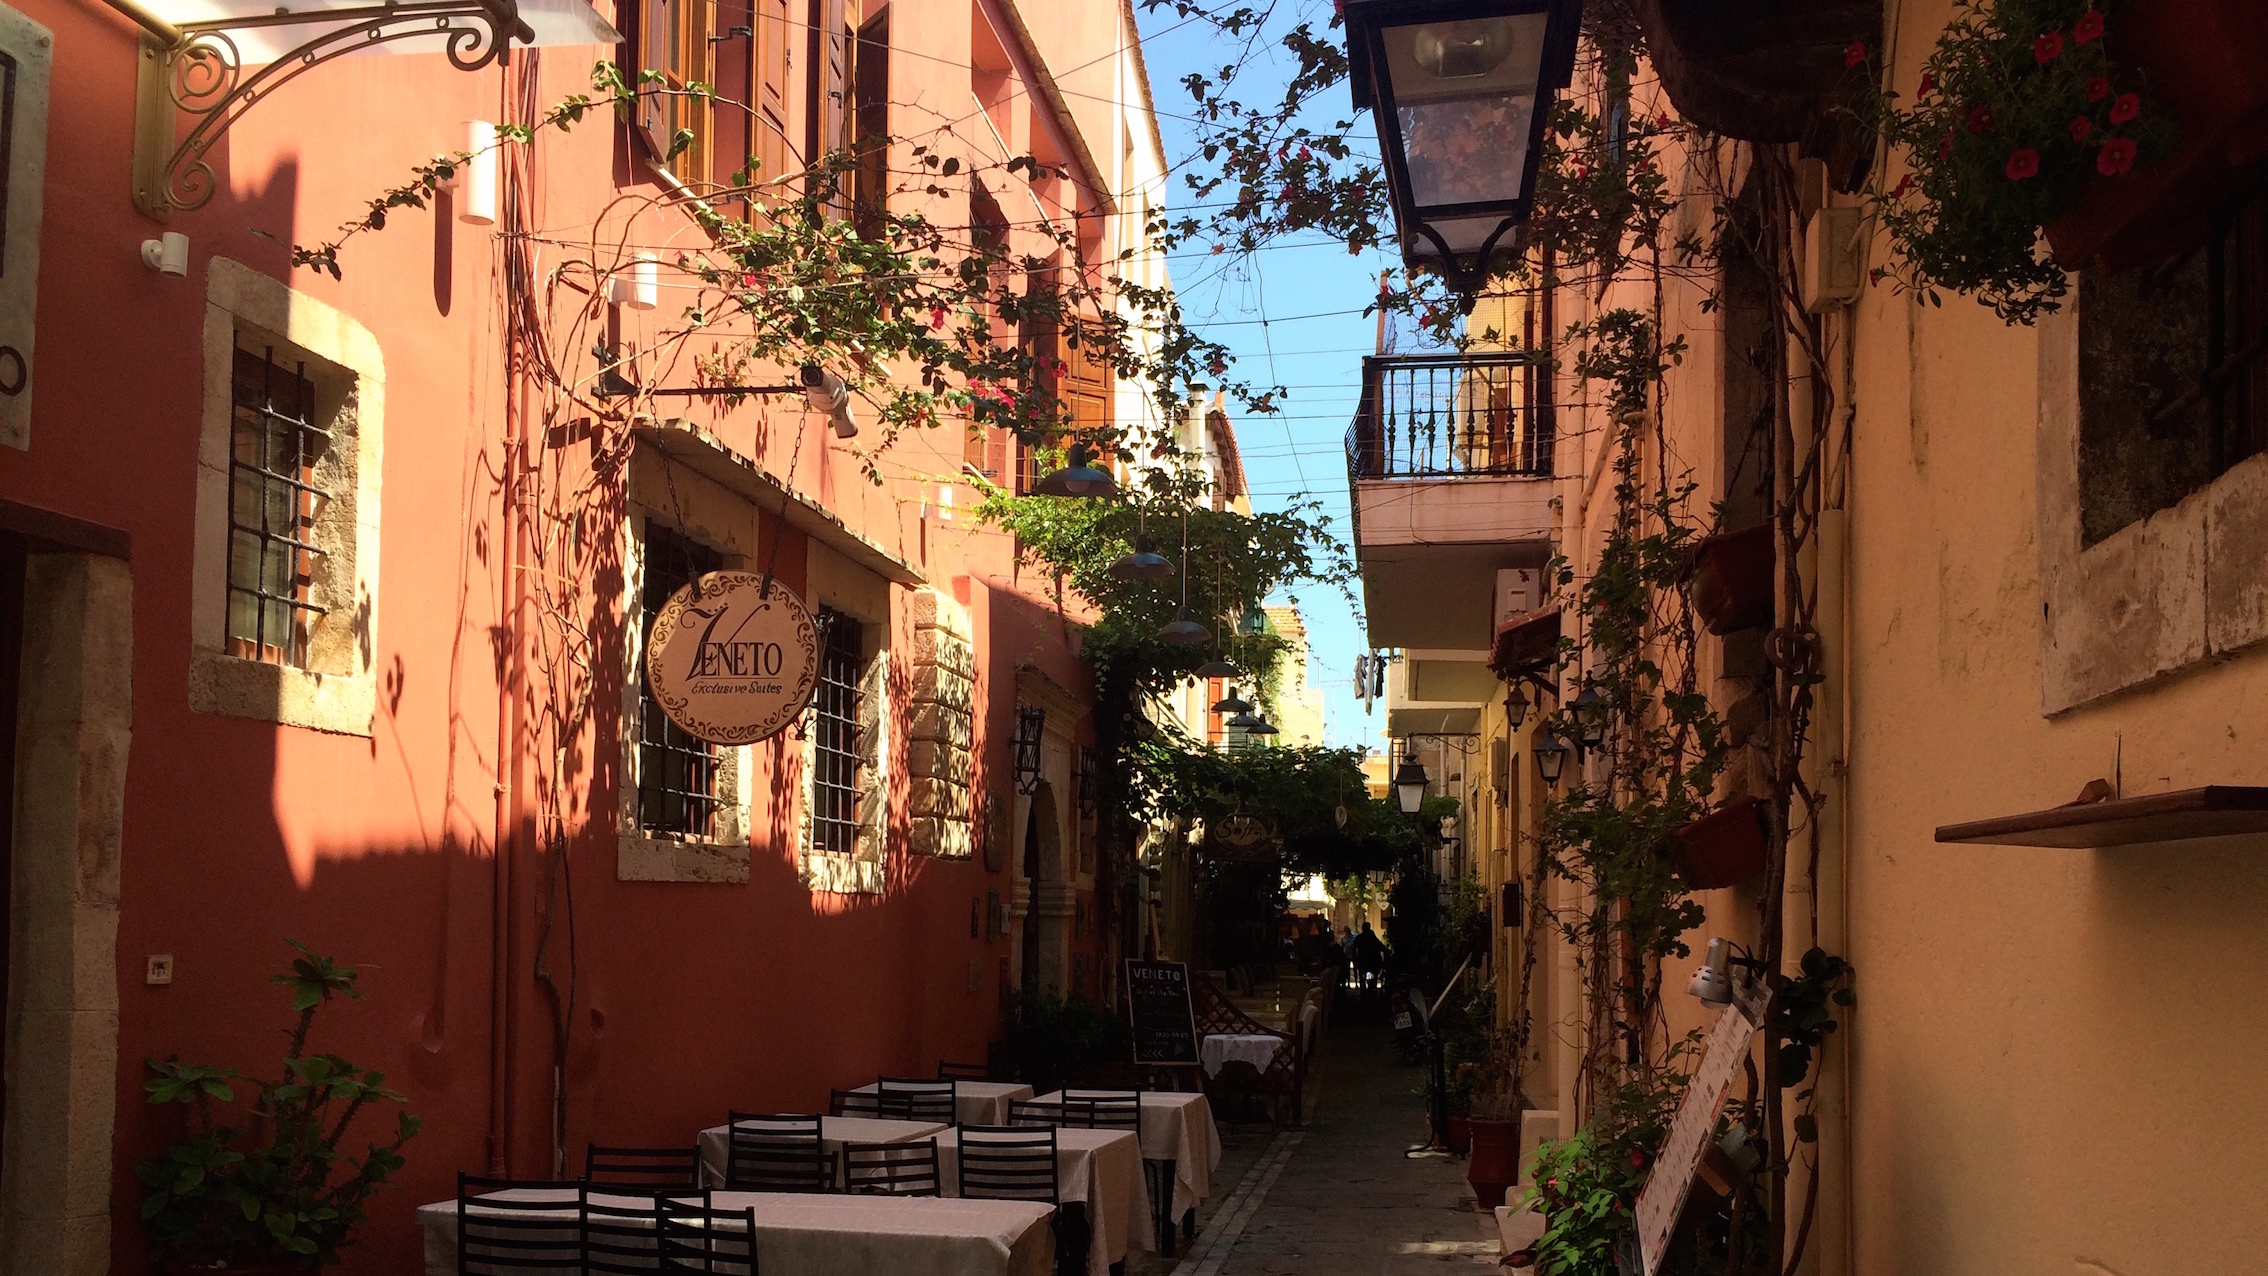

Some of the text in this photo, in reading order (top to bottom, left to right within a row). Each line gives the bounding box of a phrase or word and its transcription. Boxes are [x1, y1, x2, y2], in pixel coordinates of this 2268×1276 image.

[680, 602, 783, 681] VENETO
[691, 681, 783, 695] Exclusive Suites
[1216, 819, 1262, 841] Sofra
[1133, 967, 1182, 982] VENETO
